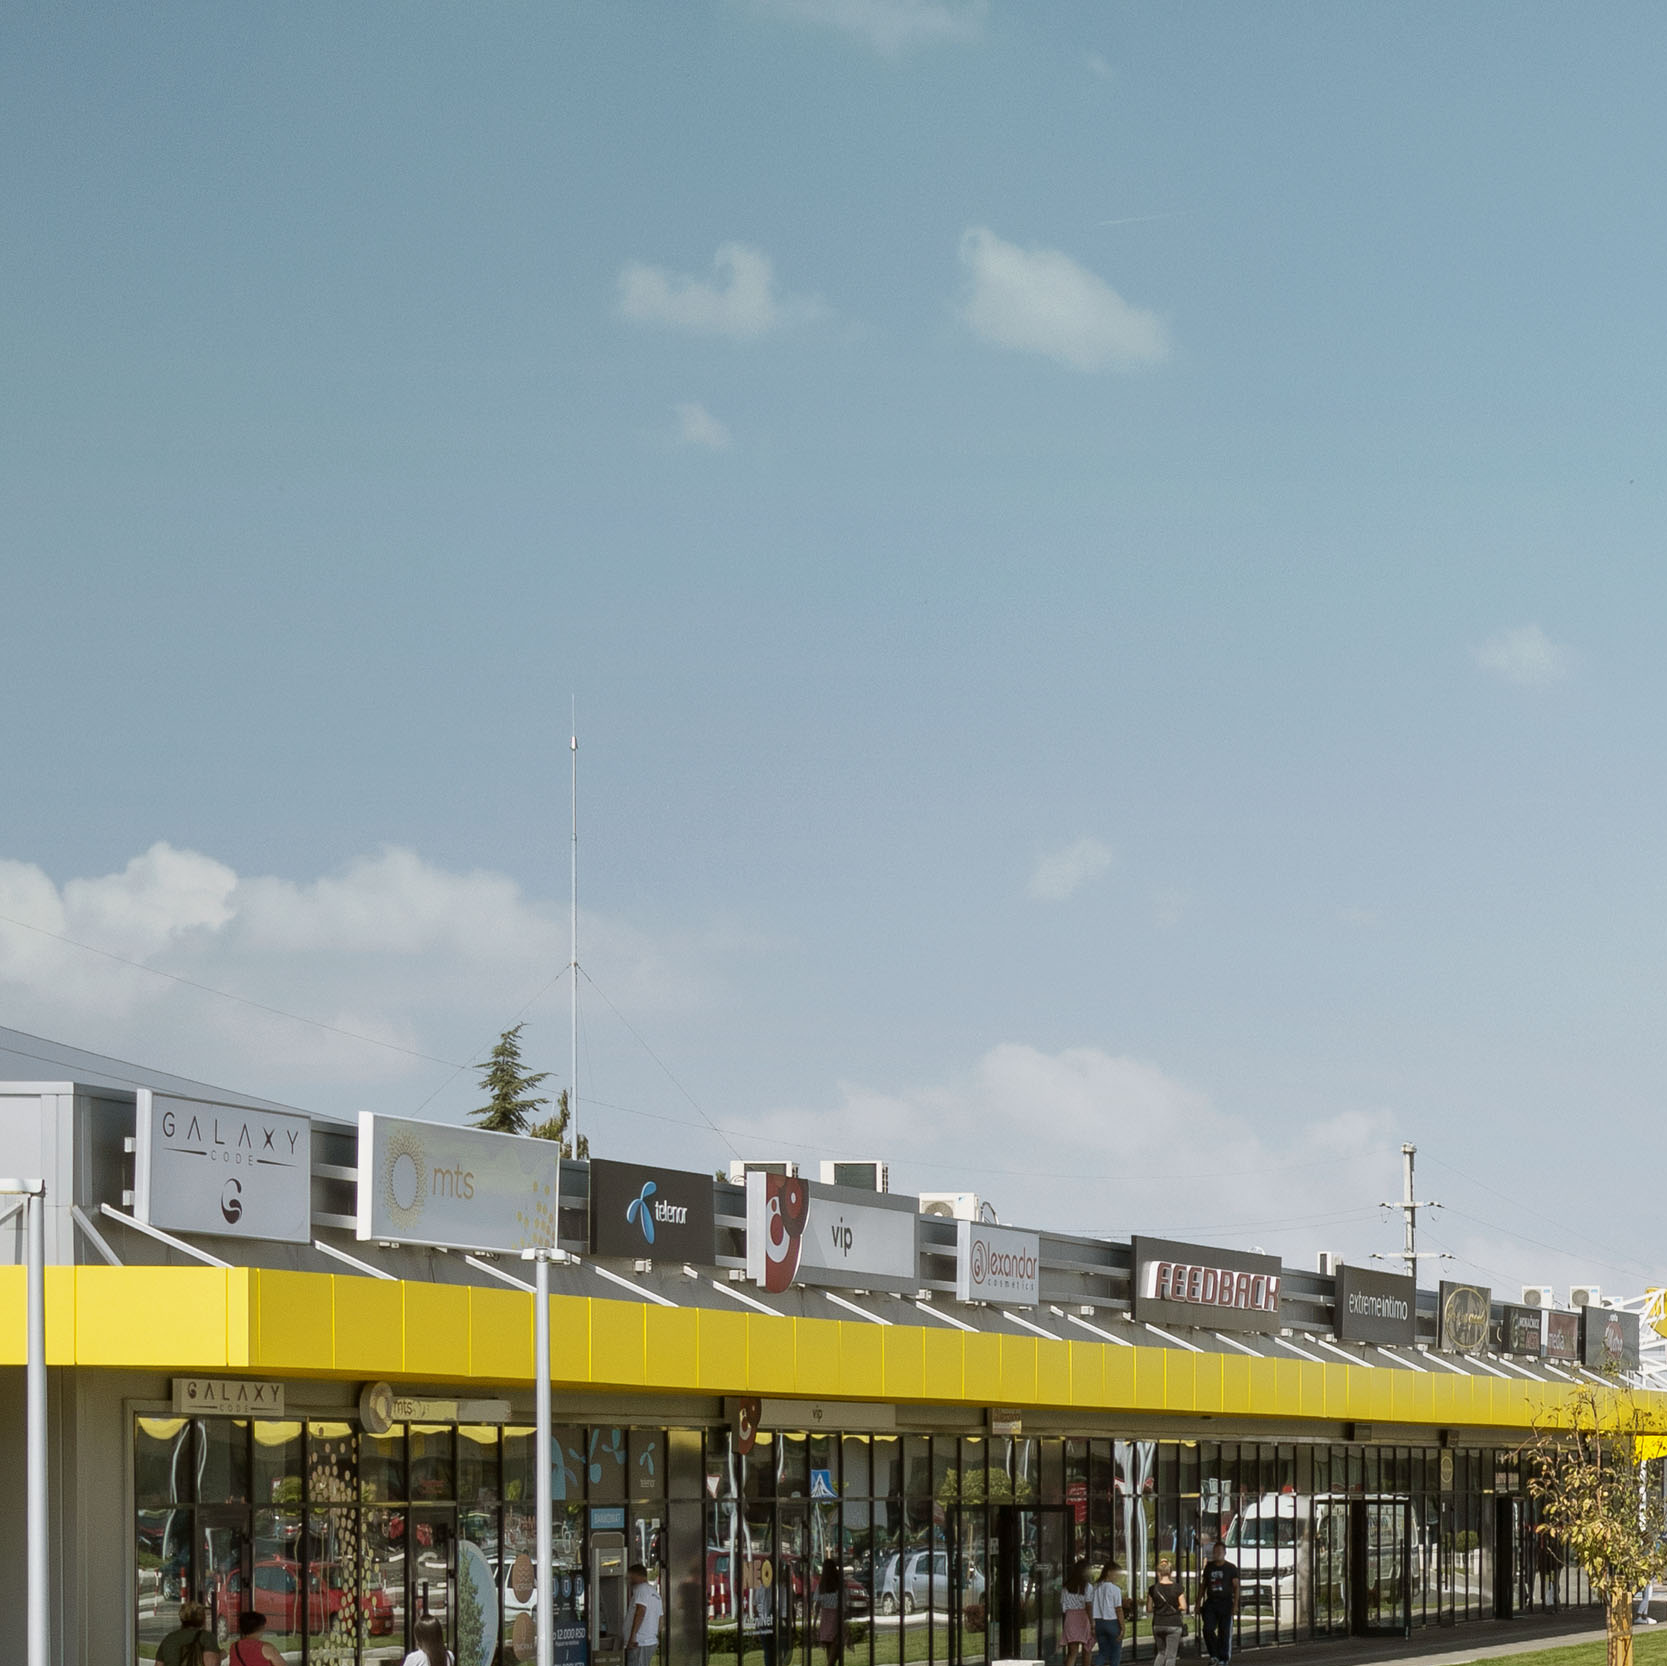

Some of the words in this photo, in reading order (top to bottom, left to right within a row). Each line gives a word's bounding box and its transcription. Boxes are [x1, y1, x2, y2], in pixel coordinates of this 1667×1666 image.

[162, 1111, 298, 1154] GALAXY
[210, 1150, 253, 1166] CODE
[432, 1163, 475, 1200] mts
[655, 1200, 688, 1224] telenor
[831, 1216, 853, 1257] vip
[1151, 1261, 1281, 1312] FEEDBACK
[188, 1382, 280, 1400] GALAXY
[220, 1404, 250, 1414] CODE
[393, 1399, 413, 1416] mts
[812, 1405, 824, 1422] vip
